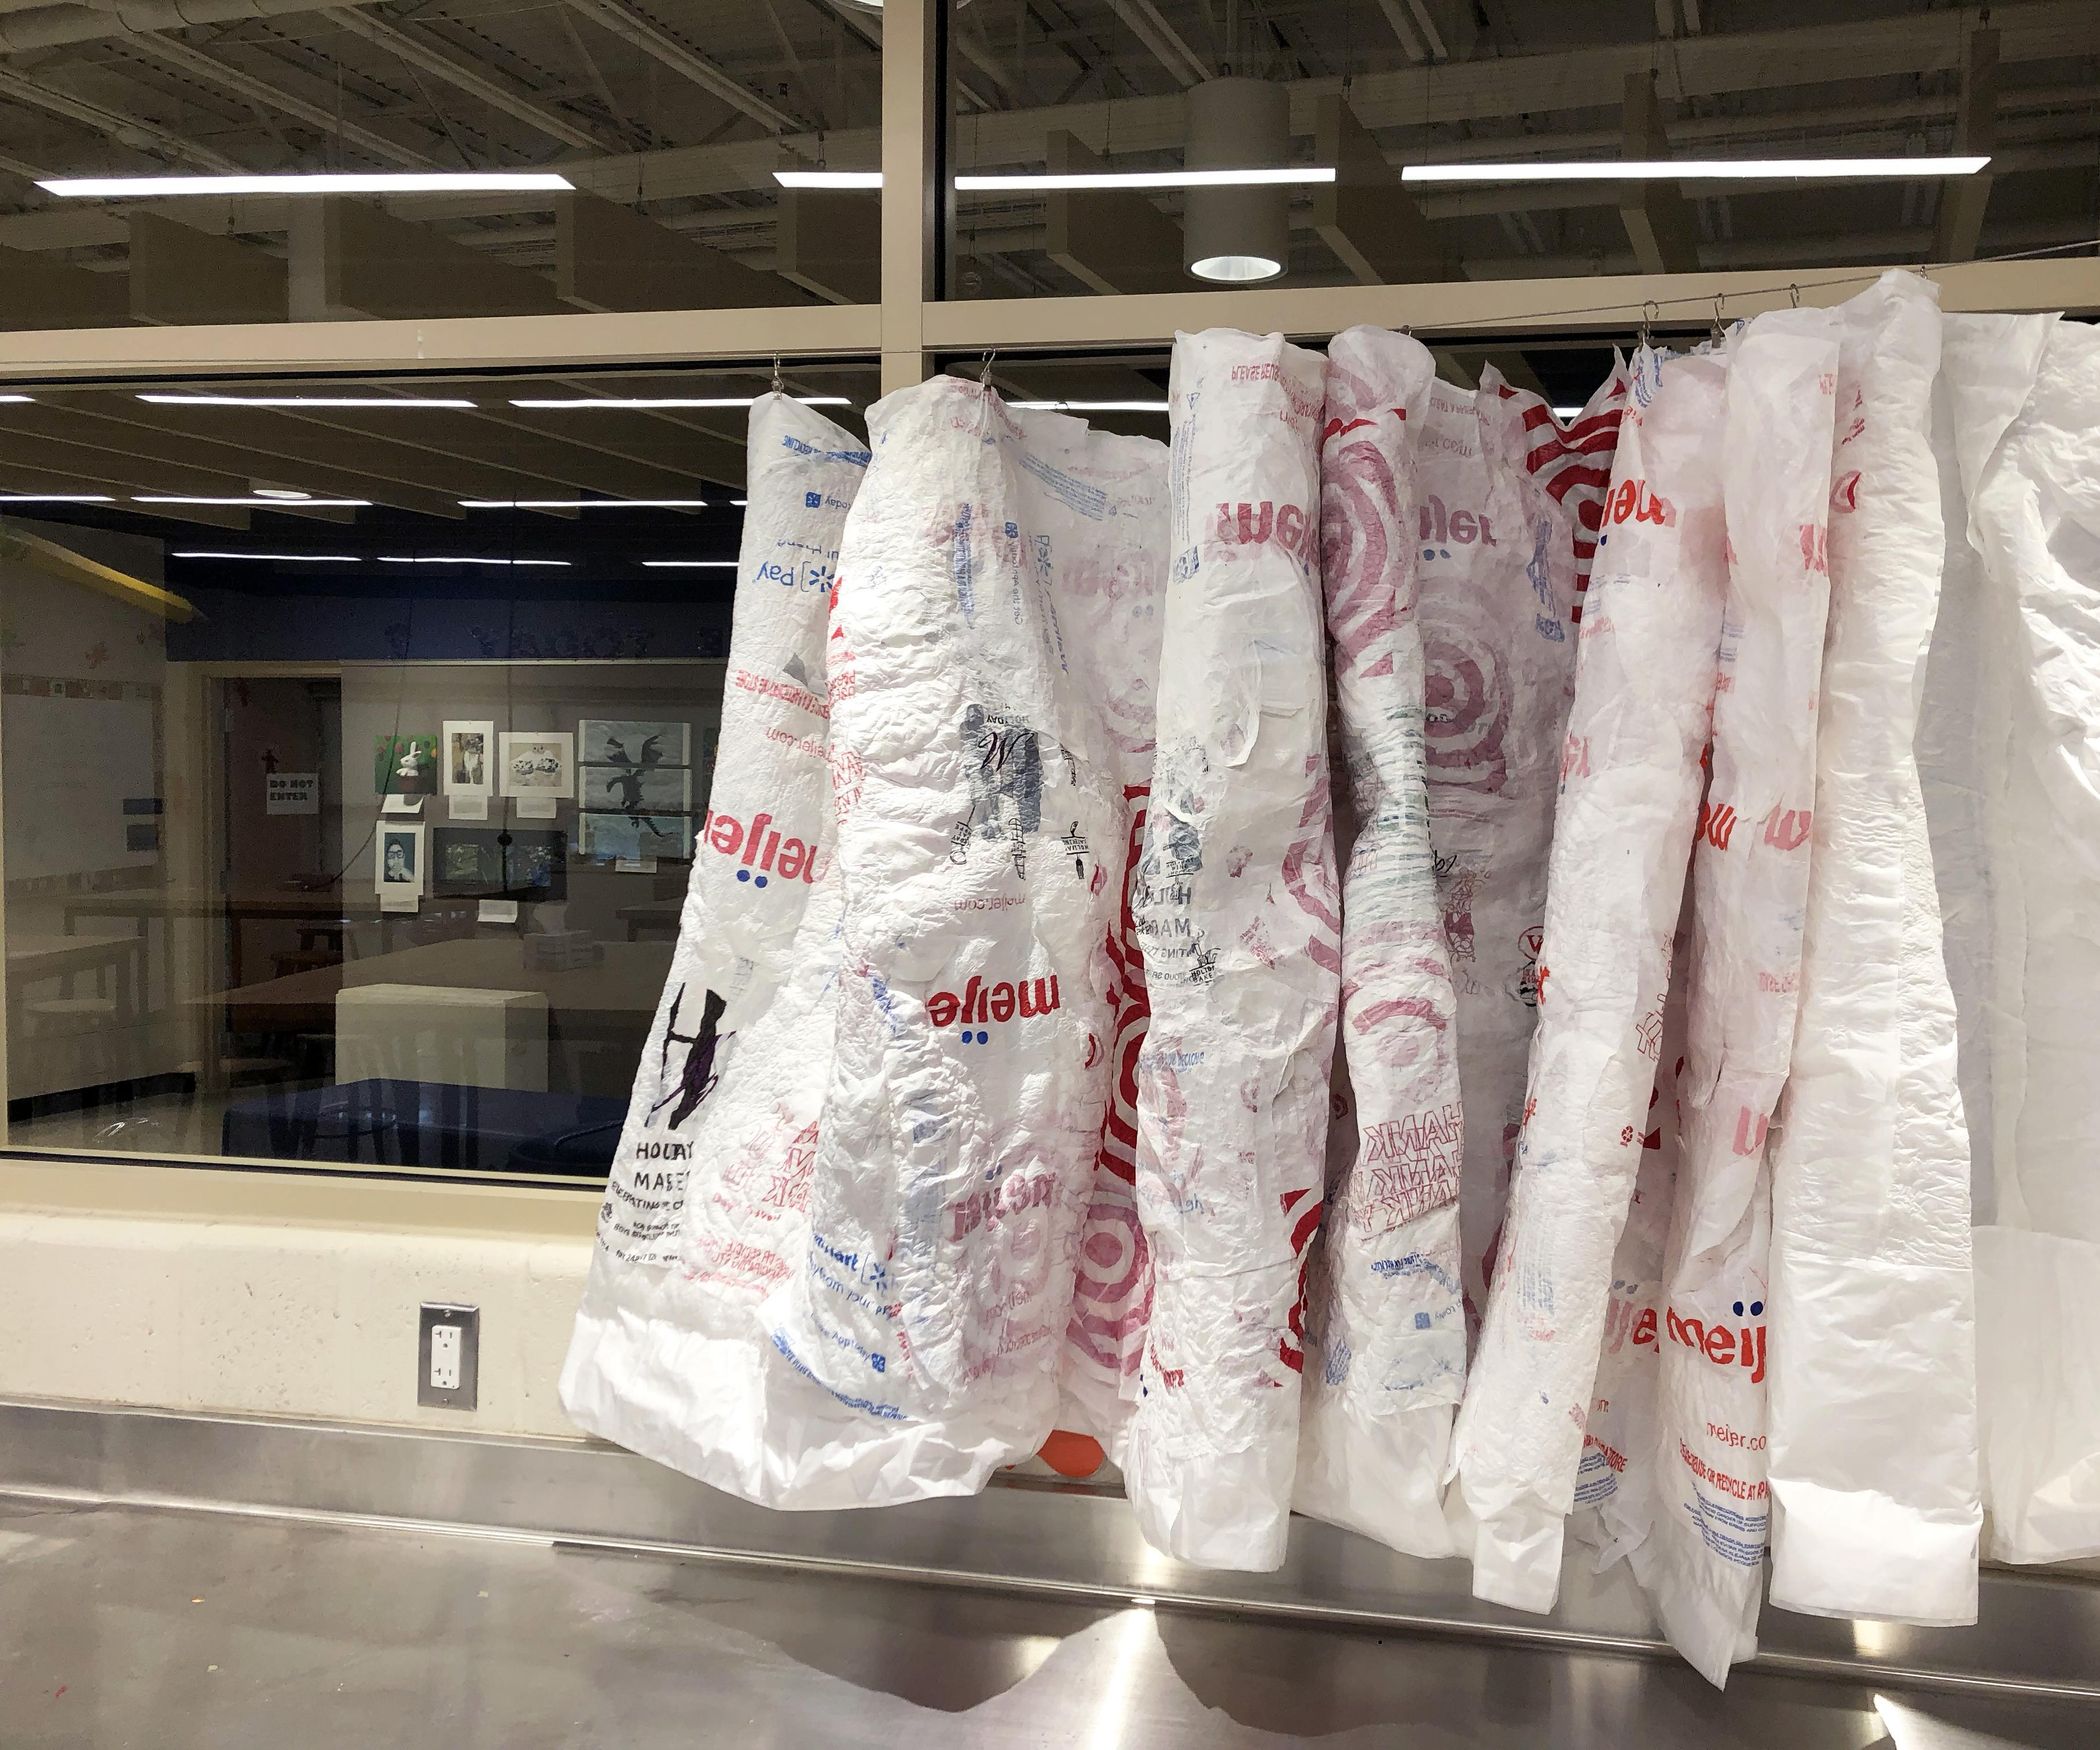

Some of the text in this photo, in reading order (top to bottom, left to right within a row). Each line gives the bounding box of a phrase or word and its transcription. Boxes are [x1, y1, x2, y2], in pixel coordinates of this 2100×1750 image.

[757, 562, 794, 588] Pay
[986, 714, 1030, 725] HODAY
[270, 779, 314, 789] DO NOT
[270, 792, 308, 801] ENTER
[1715, 1474, 1747, 1500] RECYCLE
